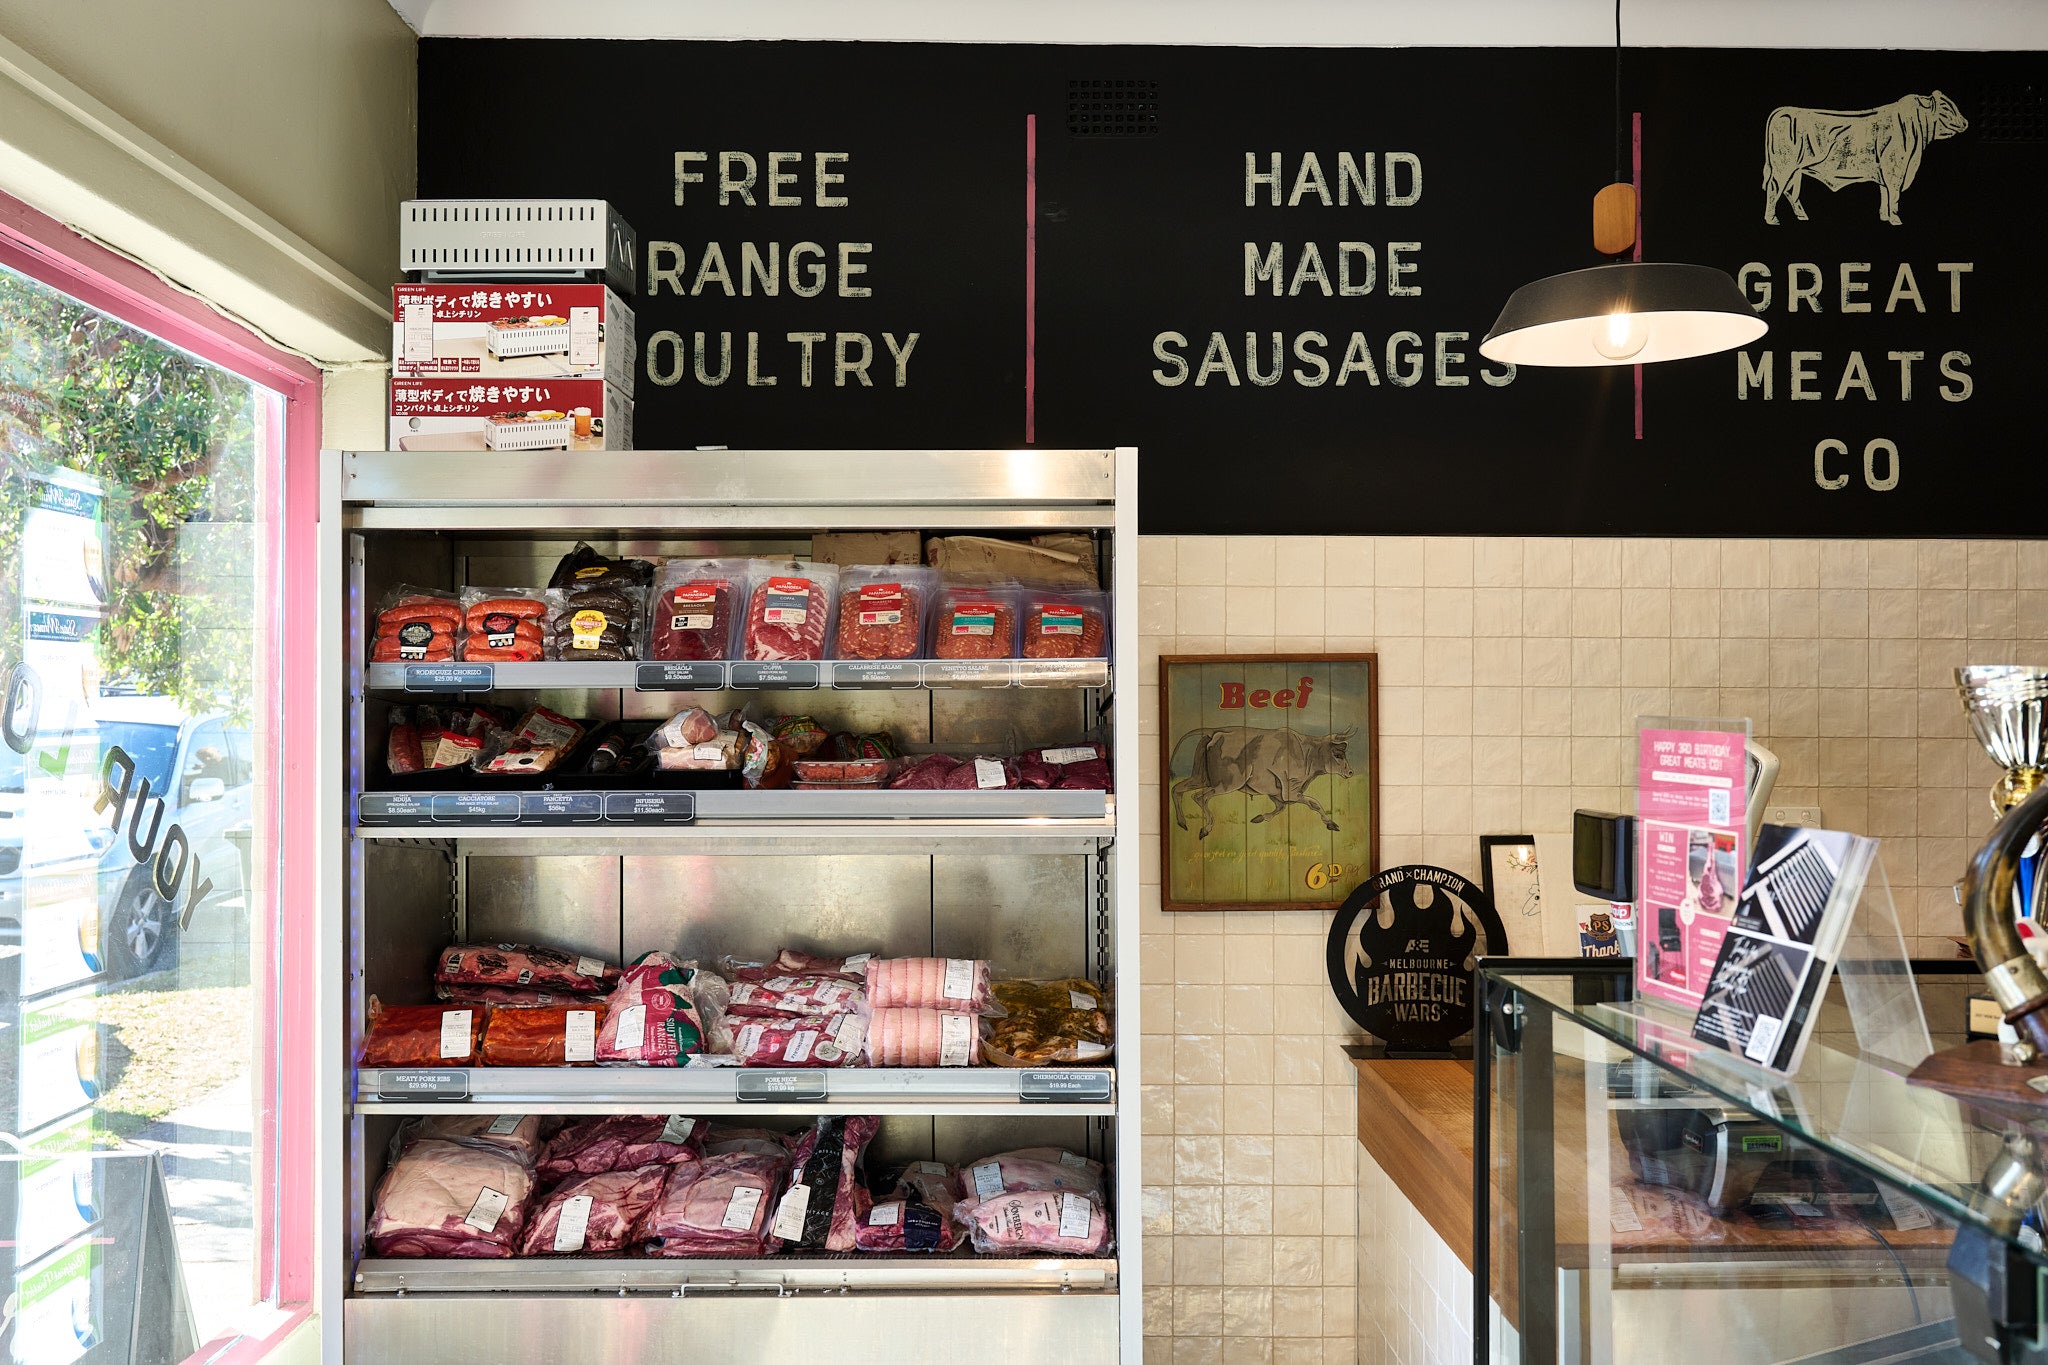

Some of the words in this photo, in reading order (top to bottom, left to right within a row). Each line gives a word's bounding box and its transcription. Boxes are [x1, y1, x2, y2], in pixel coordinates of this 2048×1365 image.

[674, 151, 849, 207] FREE
[1245, 152, 1423, 207] HAND
[647, 240, 873, 298] RANGE
[1244, 241, 1422, 297] MADE
[1737, 262, 1974, 314] GREAT
[646, 330, 920, 387] OULTRY
[395, 385, 551, 403] 薄型ボディで焼きやすい
[1737, 351, 1974, 402] MEATS
[395, 404, 479, 413] コンパクト卓上シチリン
[1814, 437, 1900, 492] CO
[1218, 676, 1314, 711] Beef
[1653, 741, 1676, 753] HAPPY
[1678, 742, 1692, 754] 3RD
[1694, 743, 1731, 758] BIRTHDAY
[1659, 754, 1681, 767] GREAT
[1683, 756, 1706, 769] MEATS
[1658, 832, 1674, 843] WIN
[1372, 870, 1404, 891] GRAND
[1413, 868, 1466, 893] CHAMPION
[1593, 921, 1609, 931] PS
[1404, 939, 1430, 953] A&E
[1389, 958, 1449, 970] MELBOURNE
[1368, 972, 1467, 1007] BARBECUE
[1394, 1003, 1441, 1022] WARS
[657, 1021, 668, 1056] RANGES
[667, 1017, 677, 1056] SOUTHER
[1008, 1199, 1025, 1240] SOVEREIGN
